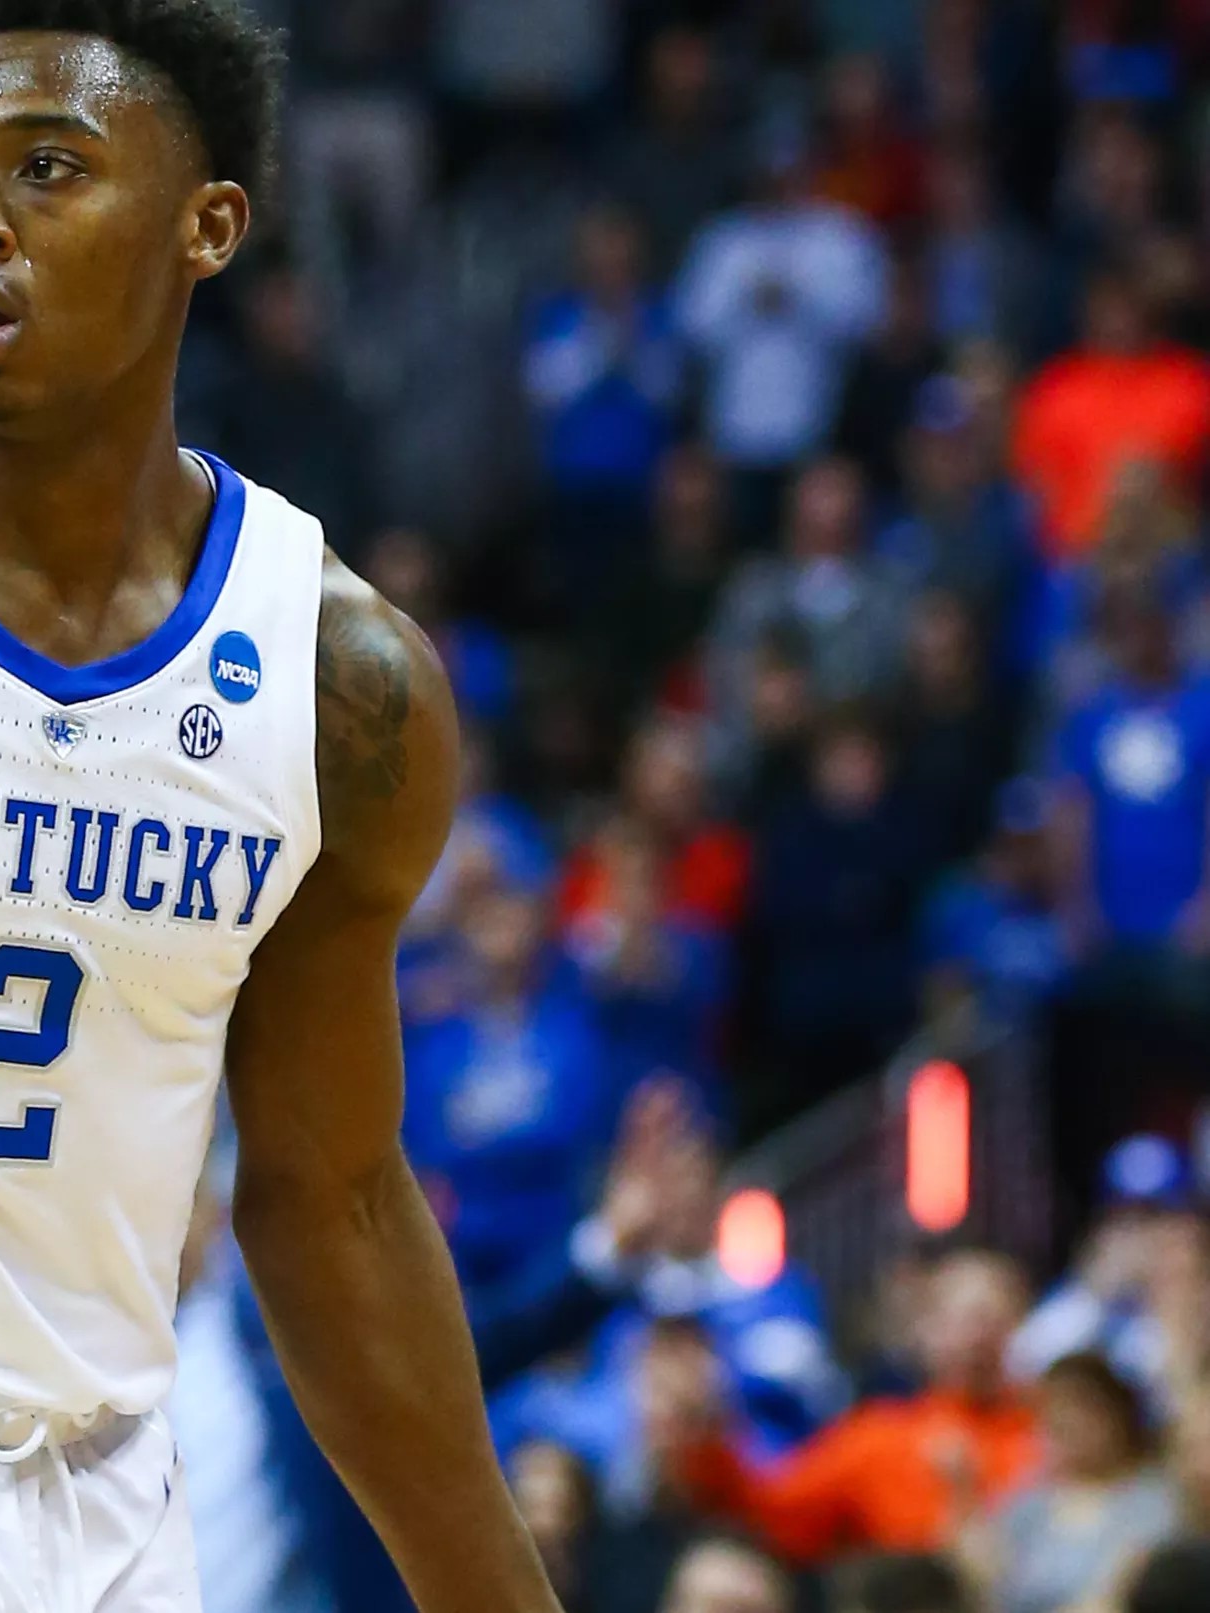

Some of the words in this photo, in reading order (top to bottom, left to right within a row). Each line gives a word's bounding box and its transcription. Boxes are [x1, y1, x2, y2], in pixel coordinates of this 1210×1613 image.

[216, 659, 260, 689] NCAA
[47, 718, 78, 744] UK
[182, 706, 221, 757] SEC
